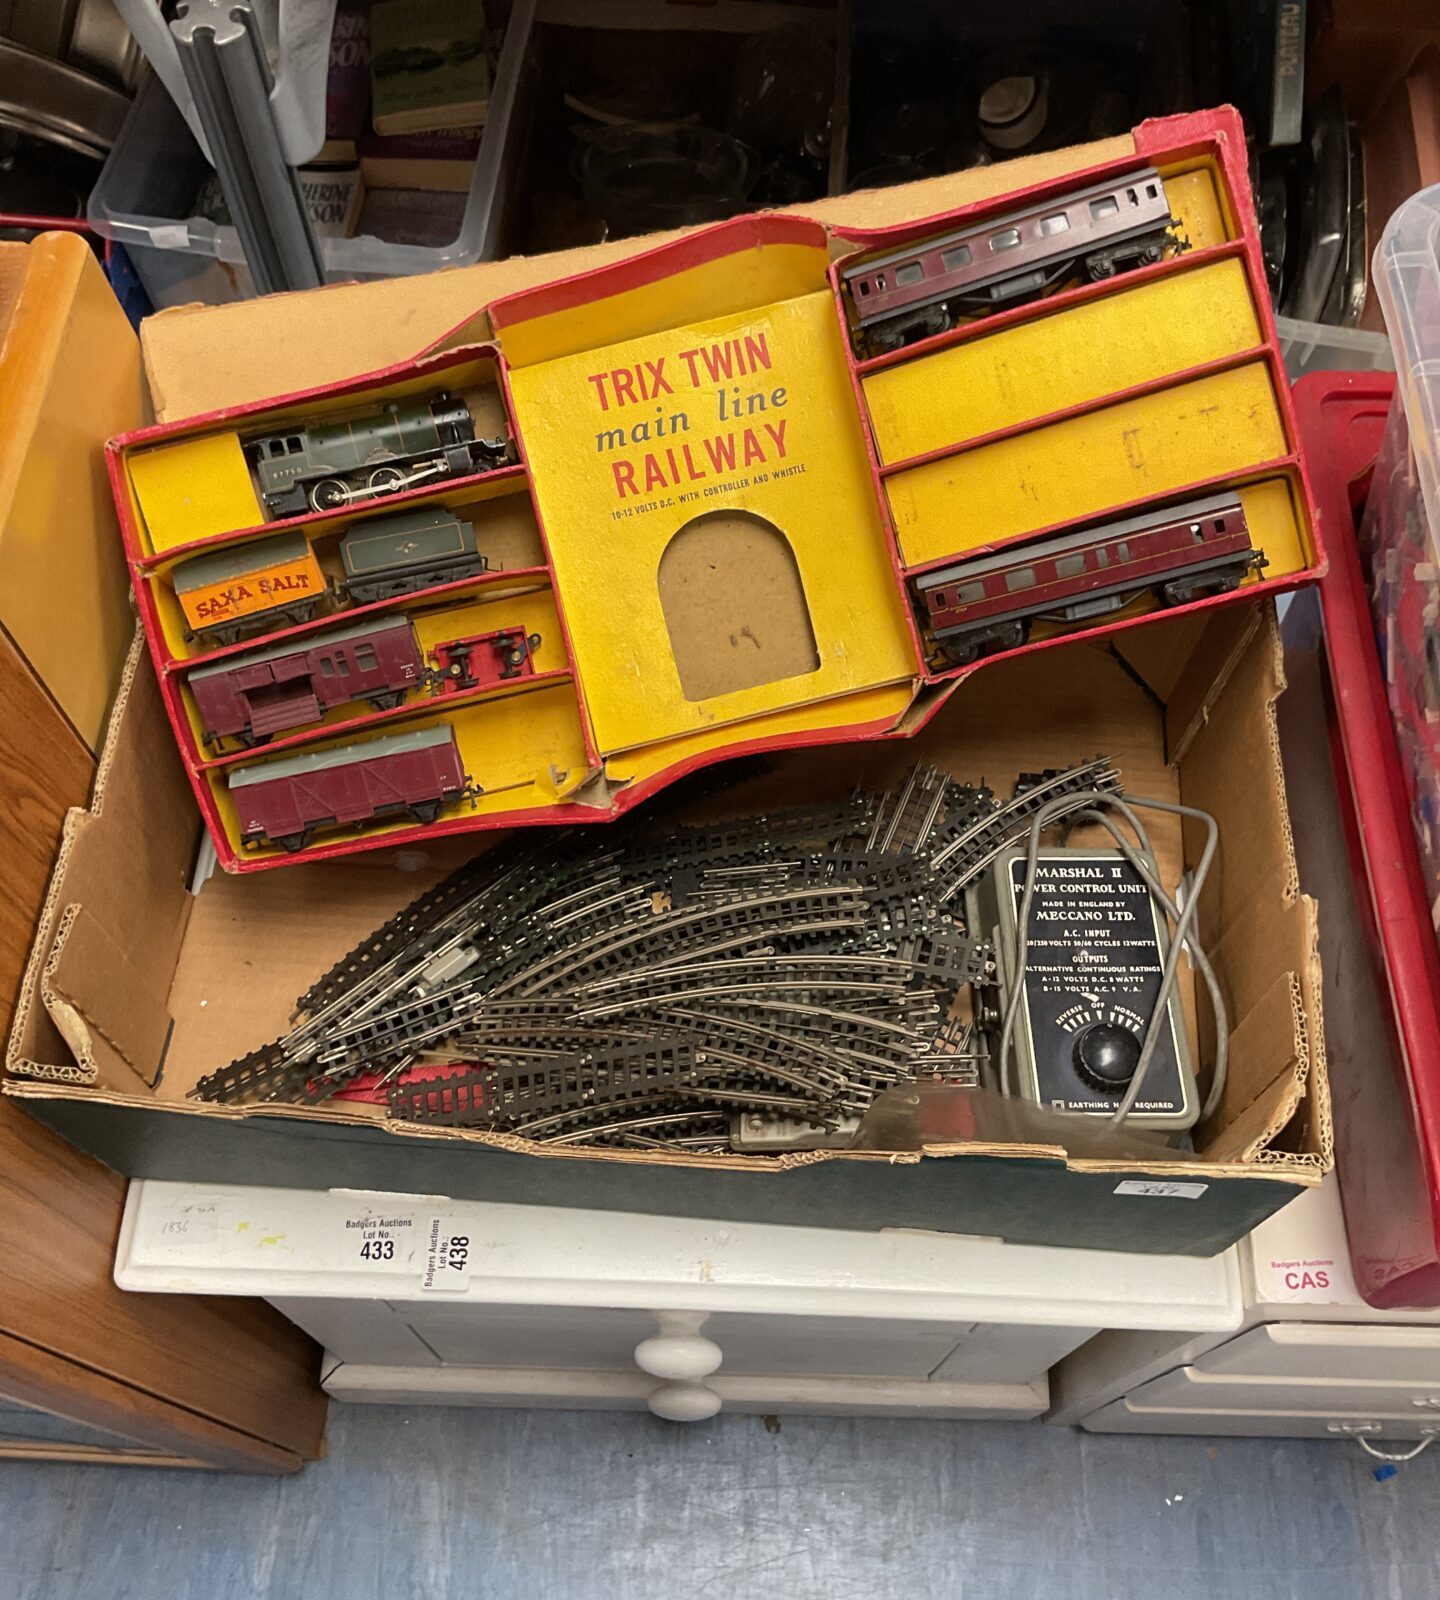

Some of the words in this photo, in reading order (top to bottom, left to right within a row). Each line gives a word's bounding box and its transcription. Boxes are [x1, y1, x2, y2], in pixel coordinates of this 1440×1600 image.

[588, 357, 674, 412] TRIX
[679, 332, 772, 388] TWIN
[595, 406, 690, 452] main
[717, 386, 788, 421] line
[611, 418, 788, 499] RAILWAY
[612, 508, 633, 520] 10-12
[634, 501, 658, 514] VOLTS
[659, 498, 675, 508] D.C.
[678, 491, 700, 503] WITH
[703, 478, 750, 497] CONTROLLER
[753, 473, 769, 485] AND
[772, 463, 806, 480] WHISTLE
[195, 585, 253, 619] SAXA
[258, 574, 309, 594] SALT
[1035, 867, 1104, 878] MARSHAL
[1059, 883, 1115, 893] CONTROL
[1118, 883, 1147, 893] UNIT
[1036, 911, 1103, 921] MECCANO
[1108, 911, 1136, 921] LTD.
[1063, 929, 1081, 938] A.C.
[1085, 929, 1111, 938] INPUT
[1072, 955, 1109, 963] OUTPUTS
[1025, 965, 1074, 973] ALTERNATIVE
[1055, 1004, 1083, 1025] REVERSE
[1114, 1004, 1145, 1026] NORMAL
[1068, 1101, 1110, 1109] EARTHING
[1134, 1101, 1174, 1109] REQUIRED
[345, 1219, 377, 1229] Badgers
[379, 1218, 412, 1227] Auctions
[363, 1231, 376, 1239] Lot
[428, 1219, 440, 1253] Auctions
[360, 1240, 394, 1260] 433
[448, 1236, 470, 1271] 438
[437, 1253, 447, 1269] Lot
[1271, 1261, 1300, 1269] Badgers
[1302, 1259, 1334, 1267] Auctions
[424, 1255, 436, 1287] Badgers
[1285, 1271, 1330, 1290] CAS
